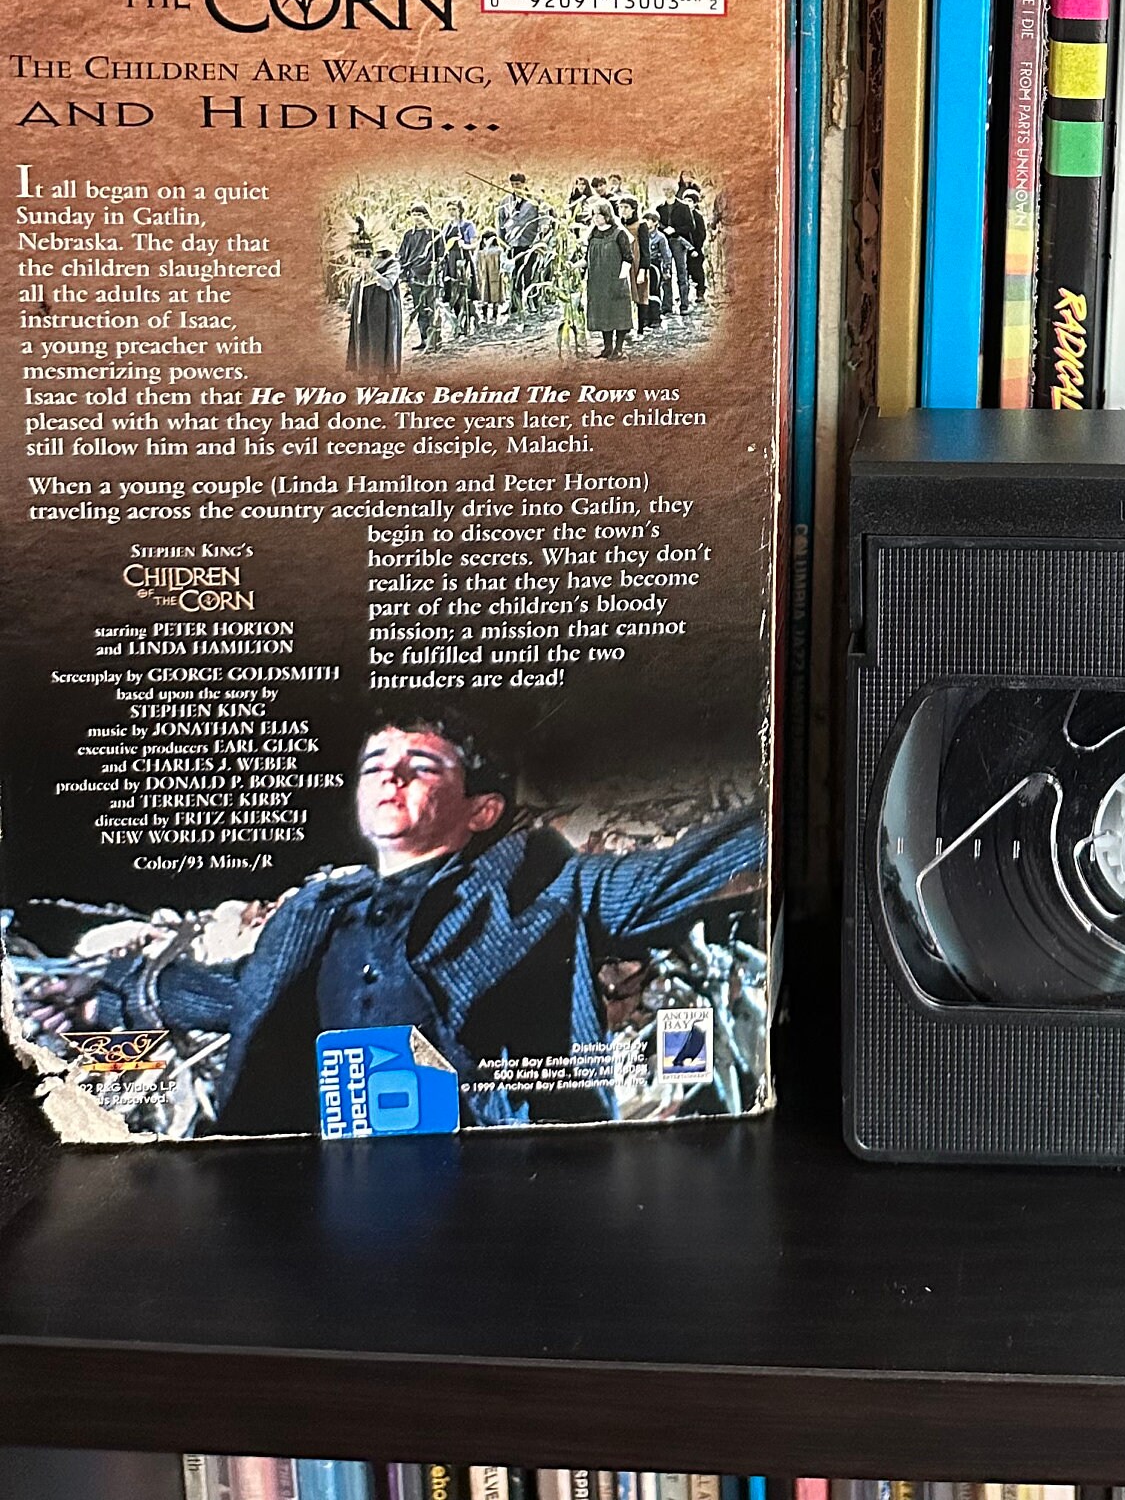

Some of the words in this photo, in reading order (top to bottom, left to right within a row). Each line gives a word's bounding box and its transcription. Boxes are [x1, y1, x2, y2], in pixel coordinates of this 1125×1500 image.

[1022, 18, 1035, 39] DIE
[1019, 61, 1032, 100] FROM
[15, 100, 155, 127] AND
[1017, 105, 1031, 143] PARTS
[16, 164, 46, 200] It
[51, 180, 79, 201] all
[85, 180, 150, 204] began
[158, 186, 187, 200] on
[194, 187, 206, 200] a
[214, 182, 270, 204] quiet
[1015, 148, 1030, 226] UNKNOWN
[16, 206, 97, 229] Sunday
[104, 206, 127, 226] in
[133, 206, 207, 228] Gatlin,
[95, 624, 147, 638] starring
[153, 622, 207, 637] PETER
[213, 621, 294, 636] HORTON
[96, 643, 121, 656] and
[129, 642, 186, 655] LINDA
[193, 640, 293, 654] HAMILTON
[320, 1049, 342, 1139] quality
